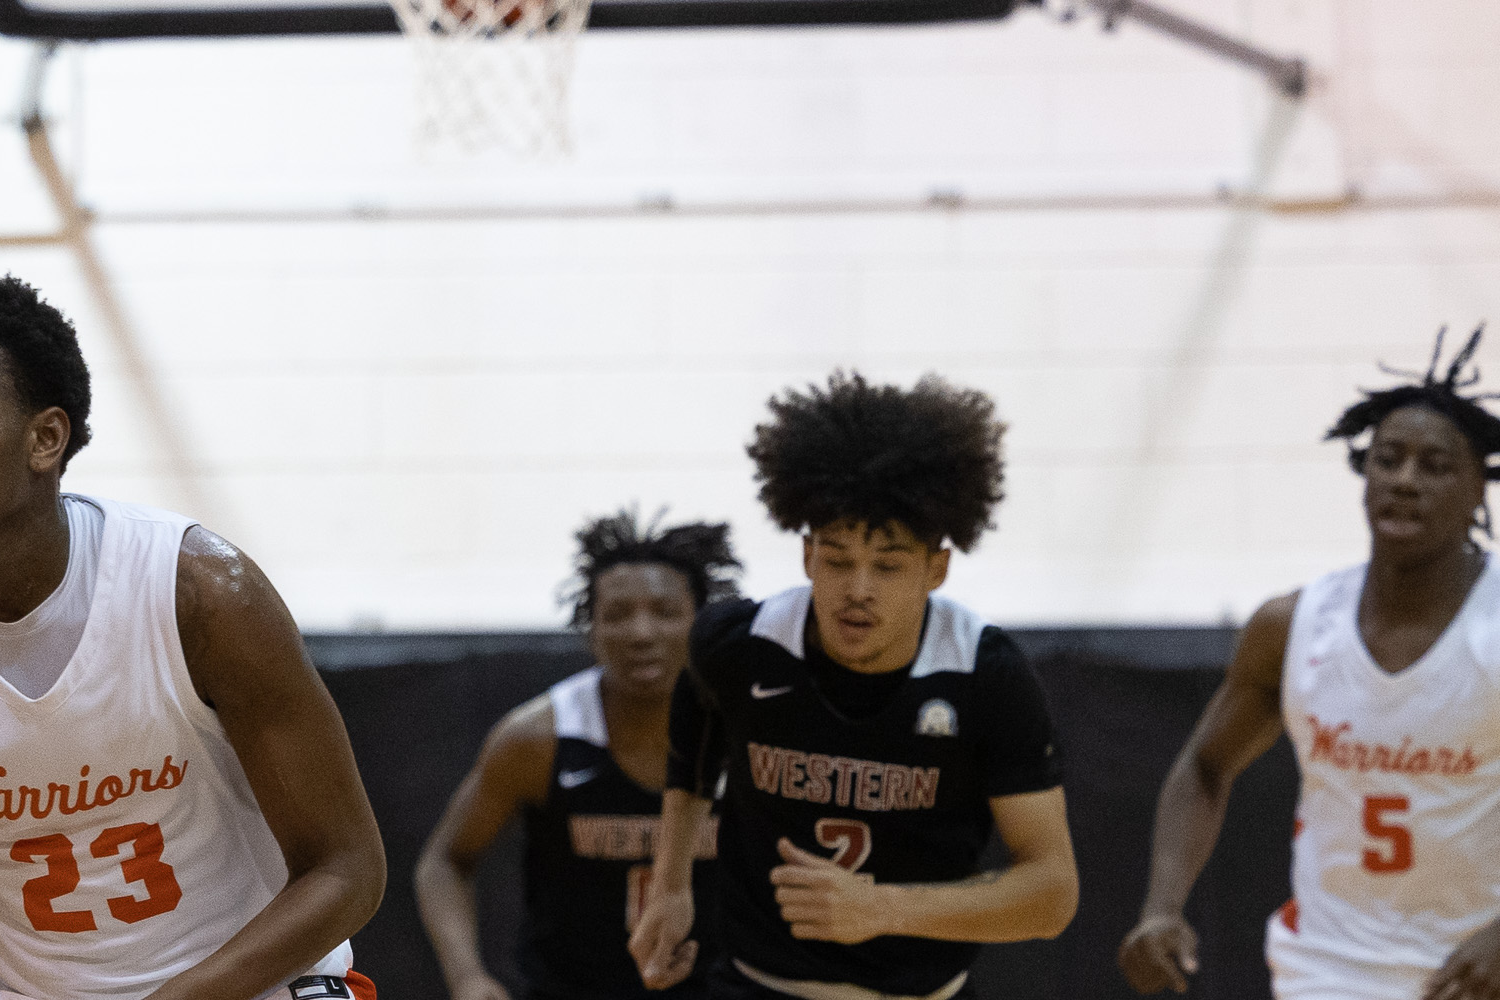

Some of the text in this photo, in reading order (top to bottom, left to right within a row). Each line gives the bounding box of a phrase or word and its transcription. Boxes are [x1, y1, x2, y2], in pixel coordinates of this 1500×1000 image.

[748, 741, 941, 811] WESTERN
[1305, 713, 1479, 776] Warriors
[1362, 794, 1414, 874] 5
[10, 821, 183, 933] 23
